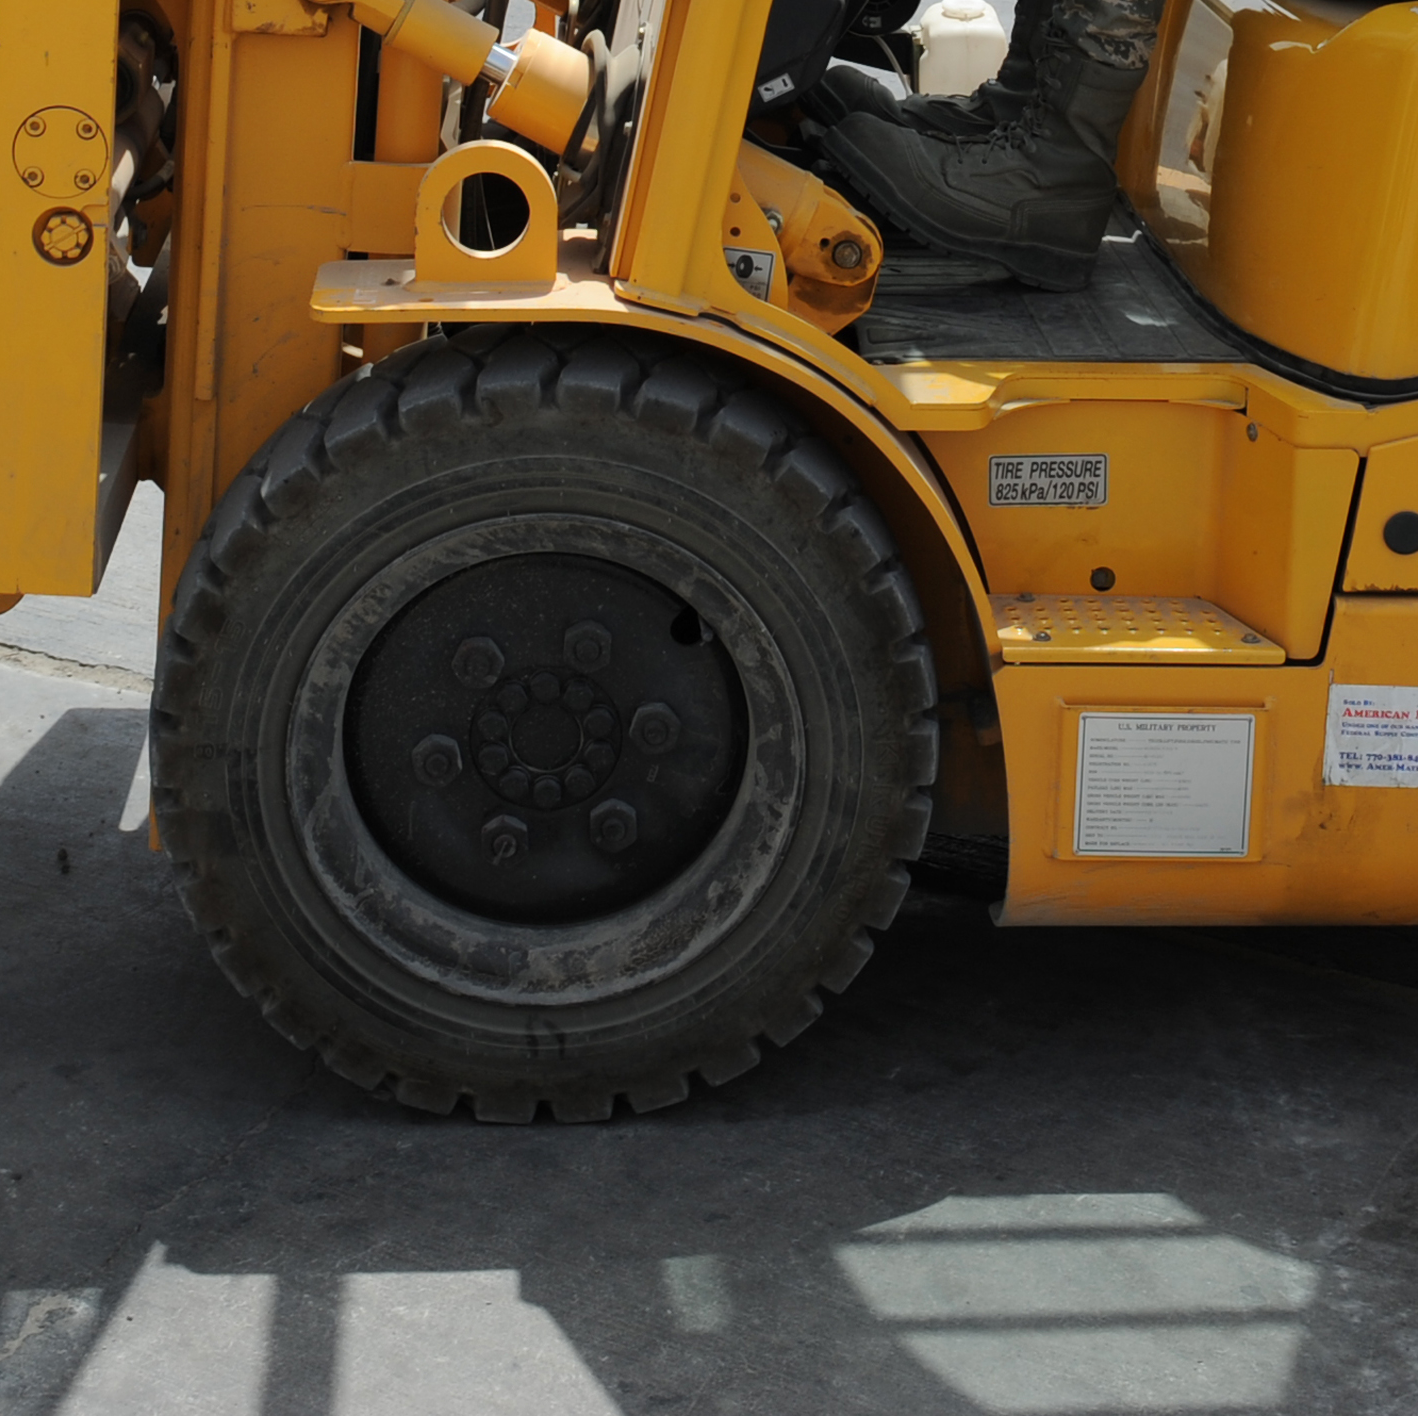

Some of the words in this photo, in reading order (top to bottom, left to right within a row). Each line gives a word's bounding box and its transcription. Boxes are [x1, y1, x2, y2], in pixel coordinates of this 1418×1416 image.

[994, 461, 1024, 480] TIRE
[1029, 459, 1103, 480] PRESSURE
[995, 482, 1020, 501] 825
[1020, 480, 1075, 501] kPa/120
[1076, 481, 1099, 500] PSI
[1135, 723, 1174, 732] MILITARY
[1176, 724, 1217, 732] PROPERTY
